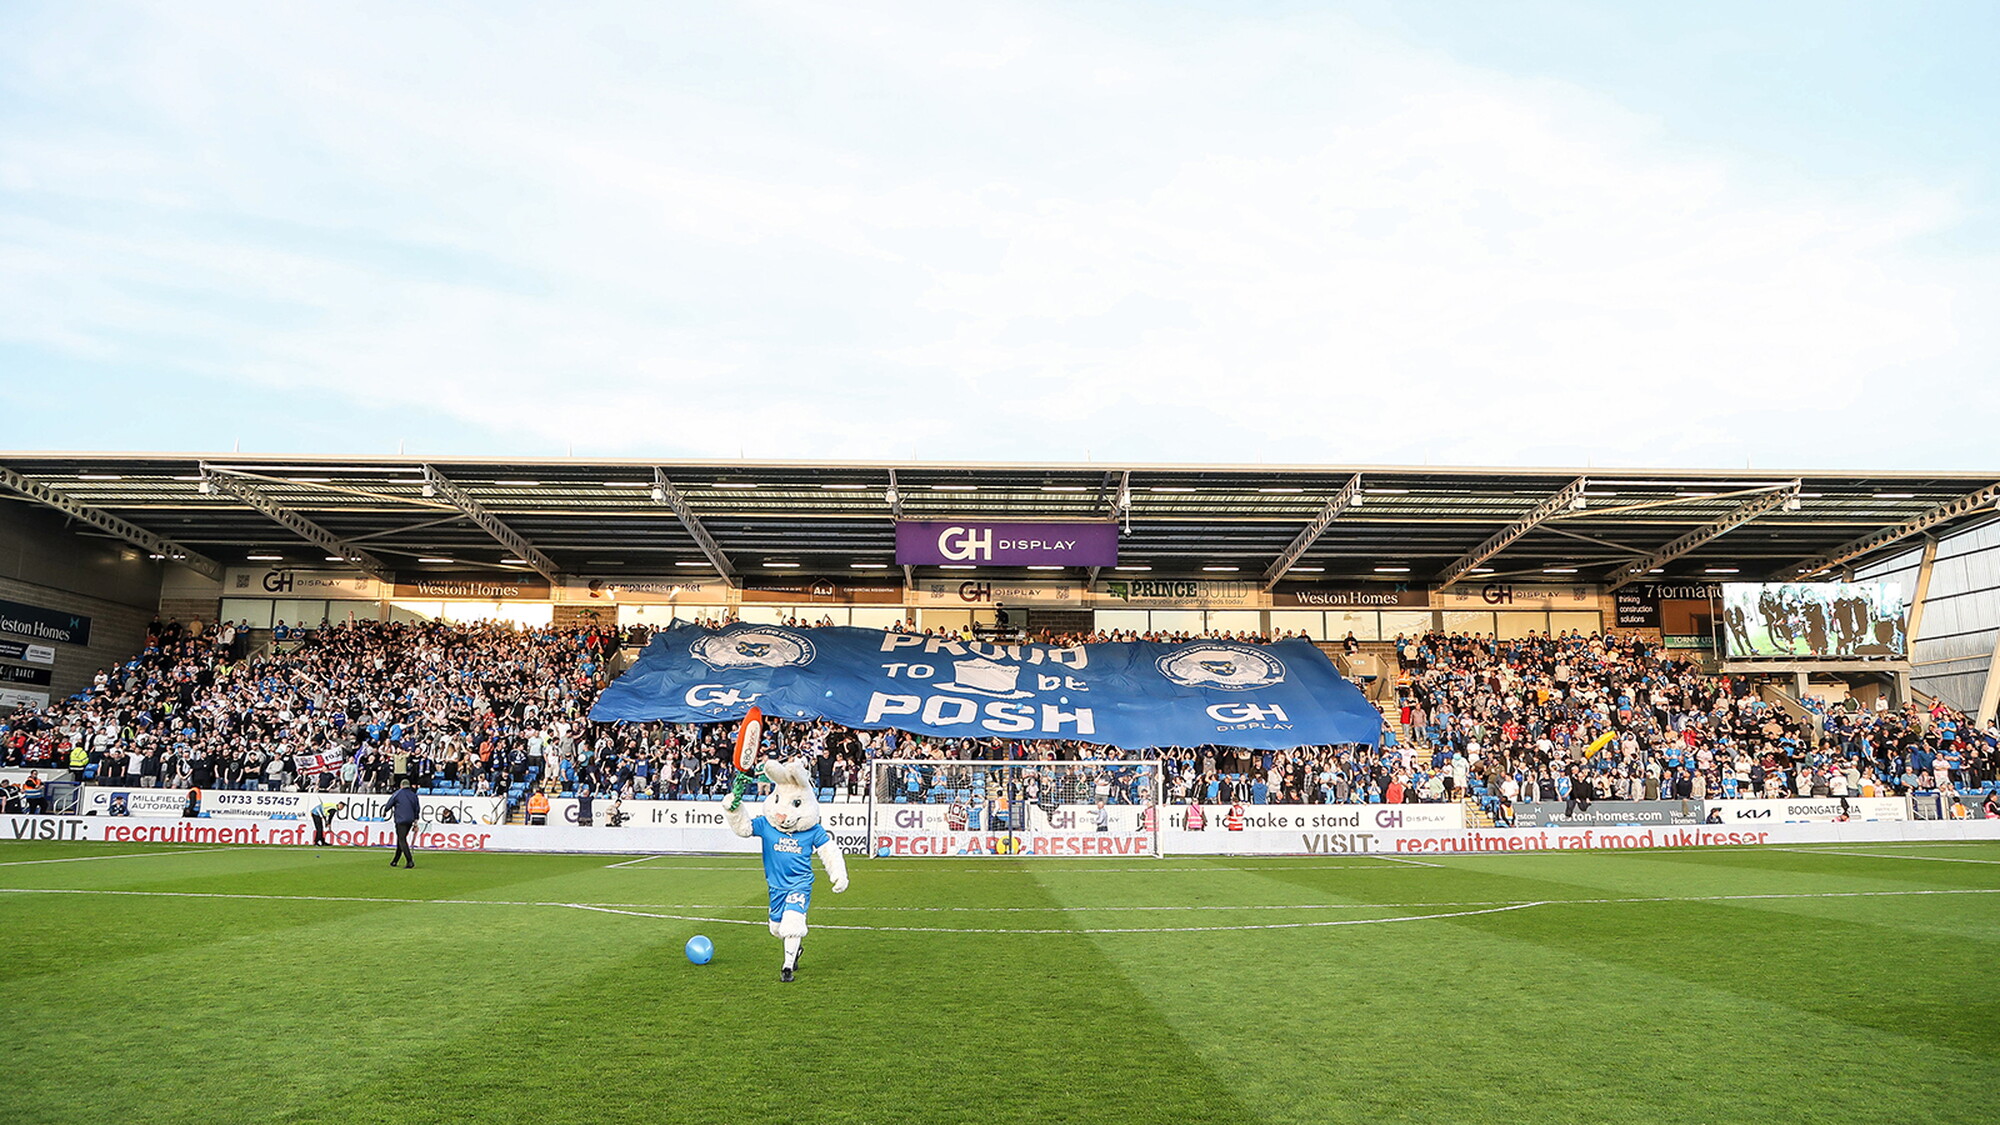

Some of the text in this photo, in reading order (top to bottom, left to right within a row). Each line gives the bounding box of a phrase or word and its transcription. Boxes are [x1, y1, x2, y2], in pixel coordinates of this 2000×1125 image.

[938, 527, 1076, 560] GH DISPLAY
[263, 571, 294, 592] GH
[417, 582, 519, 596] Weston Homes
[813, 587, 832, 595] A&J
[959, 581, 991, 602] GH
[1296, 592, 1398, 604] Weston Homes
[1482, 584, 1560, 604] GH DISPLAY
[0, 615, 71, 641] eston Homes
[881, 663, 935, 678] TO
[863, 691, 1096, 734] POSH
[1206, 703, 1290, 722] GH
[1216, 723, 1294, 732] DISPLAY
[132, 795, 187, 803] MILLFIELD
[218, 795, 300, 806] 01733 557457
[131, 803, 185, 811] AUTOPART
[337, 797, 473, 824] dalto eeds
[1737, 809, 1771, 818] KIA
[1788, 806, 1842, 815] BOONGATE
[652, 809, 724, 824] It's time
[895, 810, 923, 828] GH
[1244, 812, 1288, 827] make
[1295, 816, 1304, 827] a
[1312, 812, 1360, 827] stand
[1375, 810, 1446, 828] GH DISPLAY
[11, 818, 88, 841] VISIT:
[837, 836, 867, 846] ROYA
[1033, 836, 1148, 855] RESERVE
[1302, 833, 1380, 853] VISIT:
[839, 847, 867, 855] ORC
